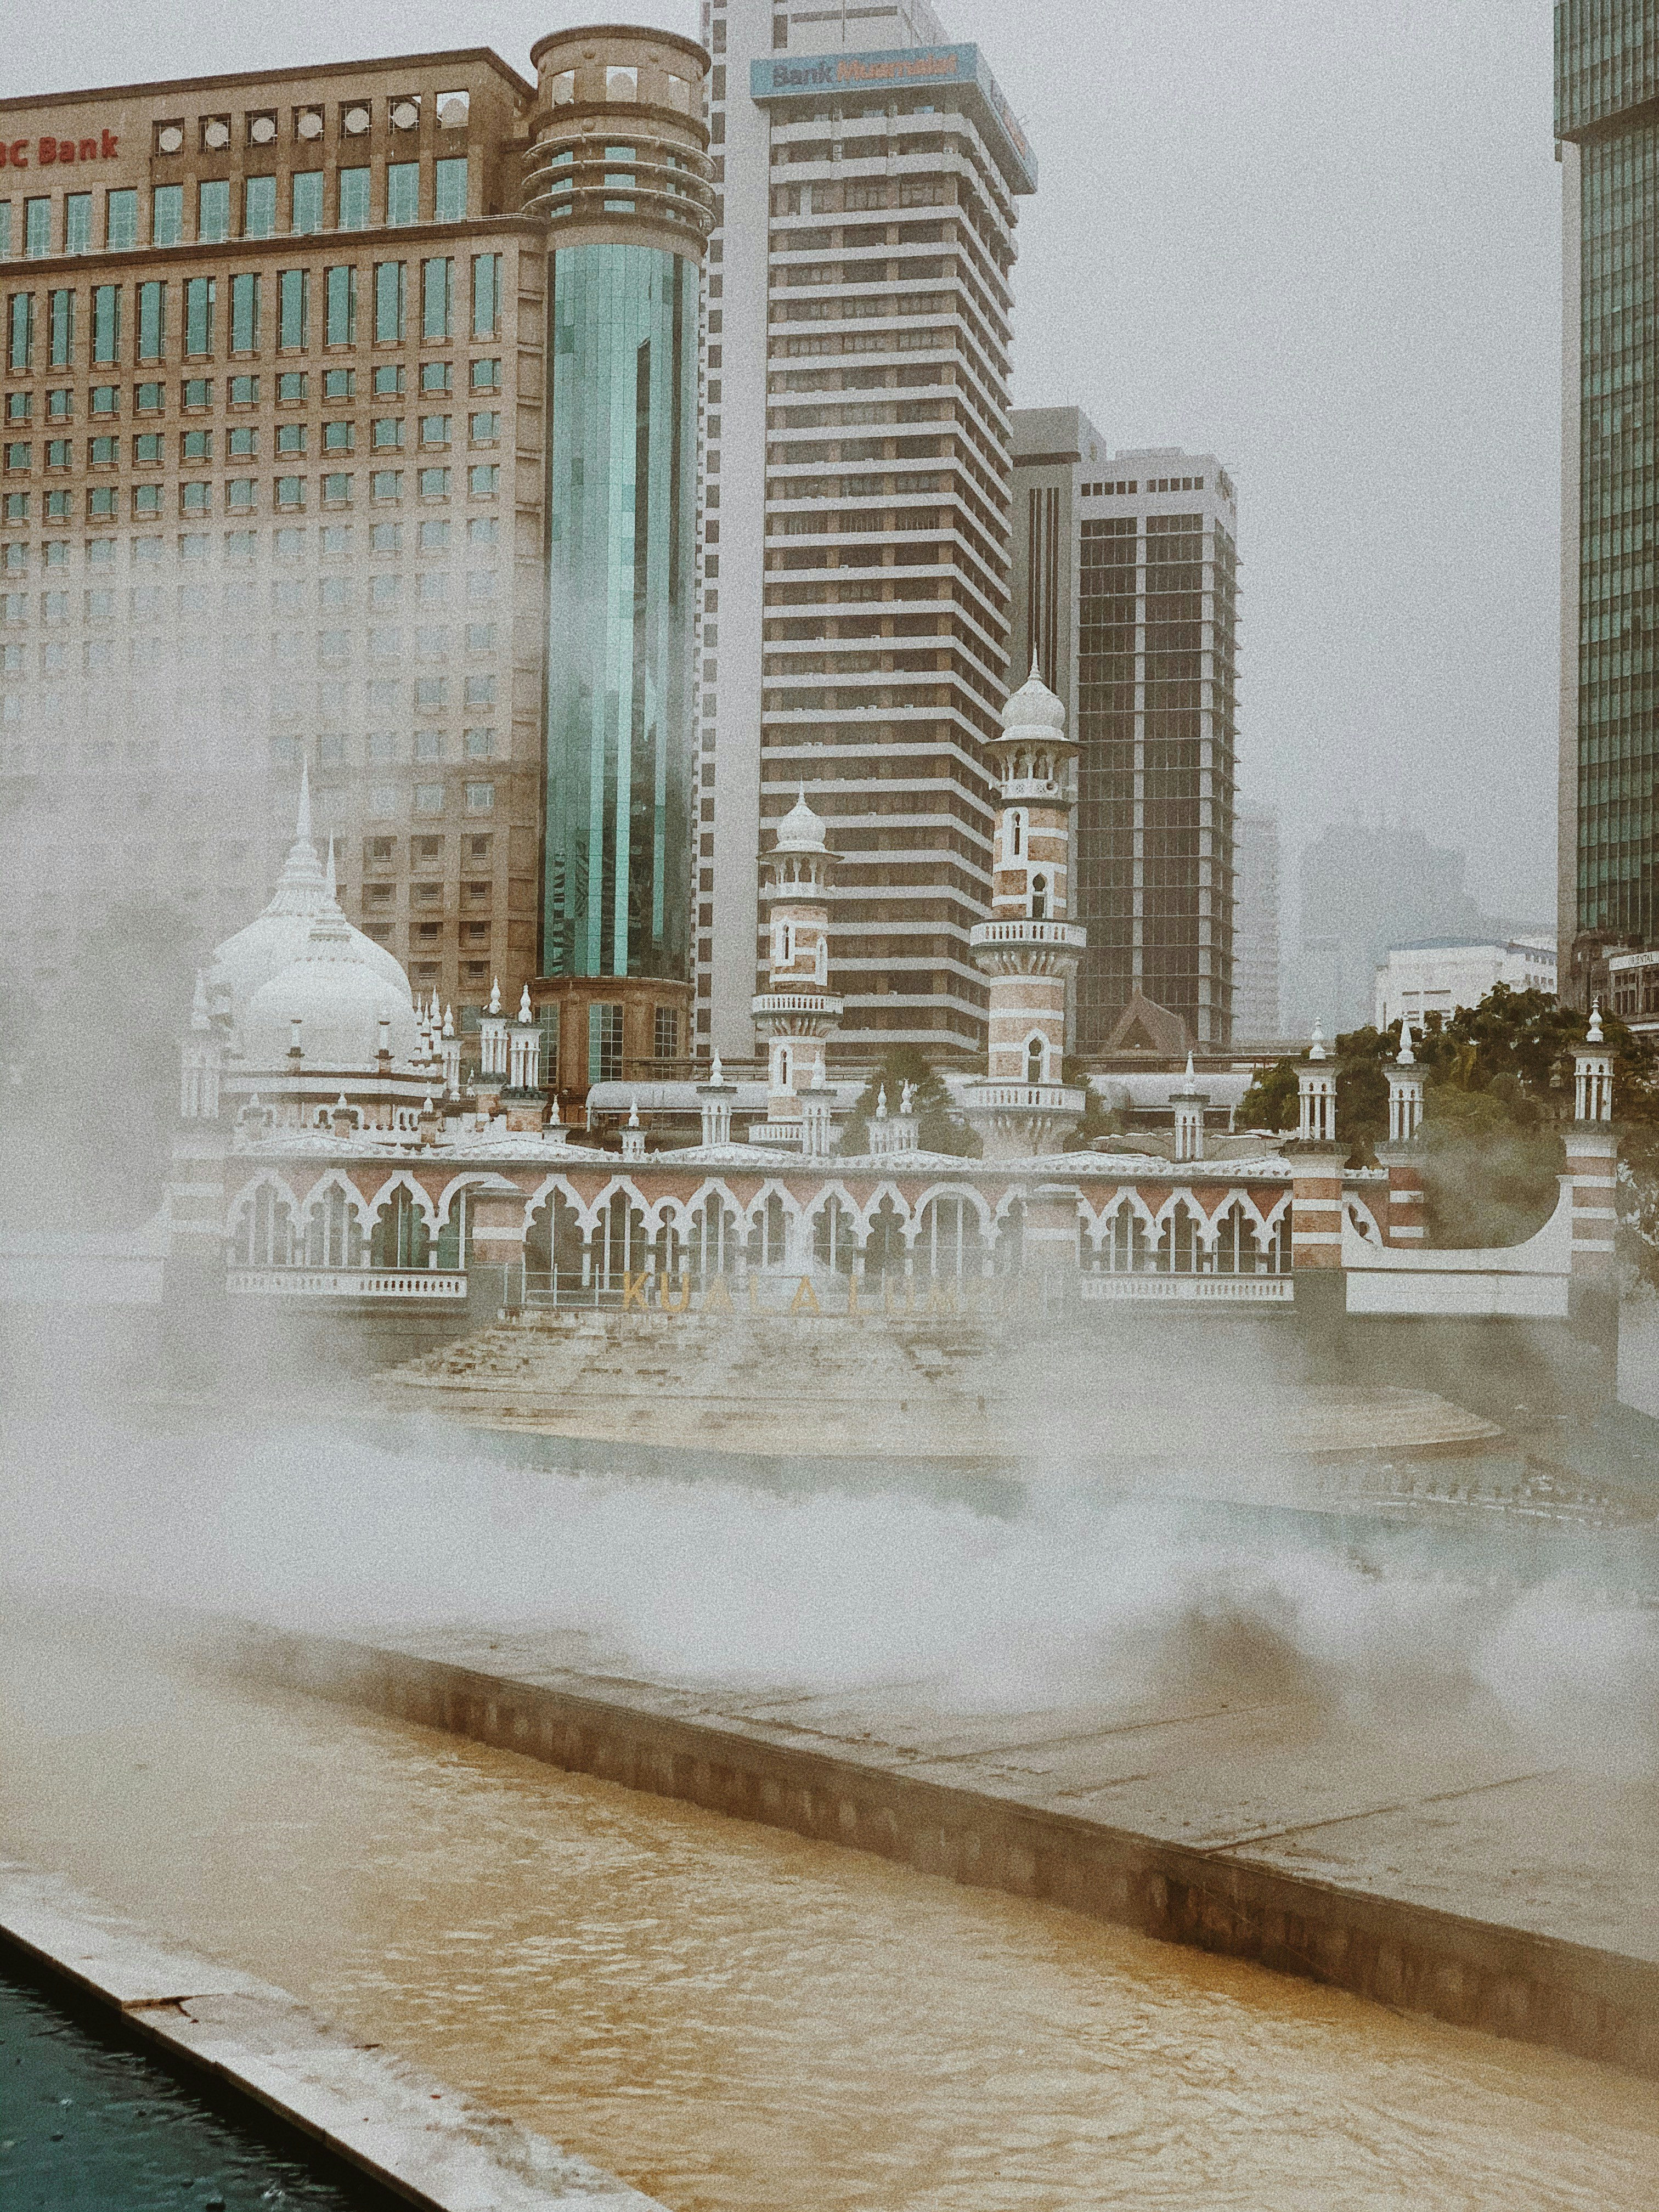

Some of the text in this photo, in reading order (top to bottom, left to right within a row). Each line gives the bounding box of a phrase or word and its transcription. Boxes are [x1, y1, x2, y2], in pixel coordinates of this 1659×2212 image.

[773, 61, 832, 87] Bank
[40, 129, 119, 165] Bank
[623, 1271, 821, 1313] KUALA
